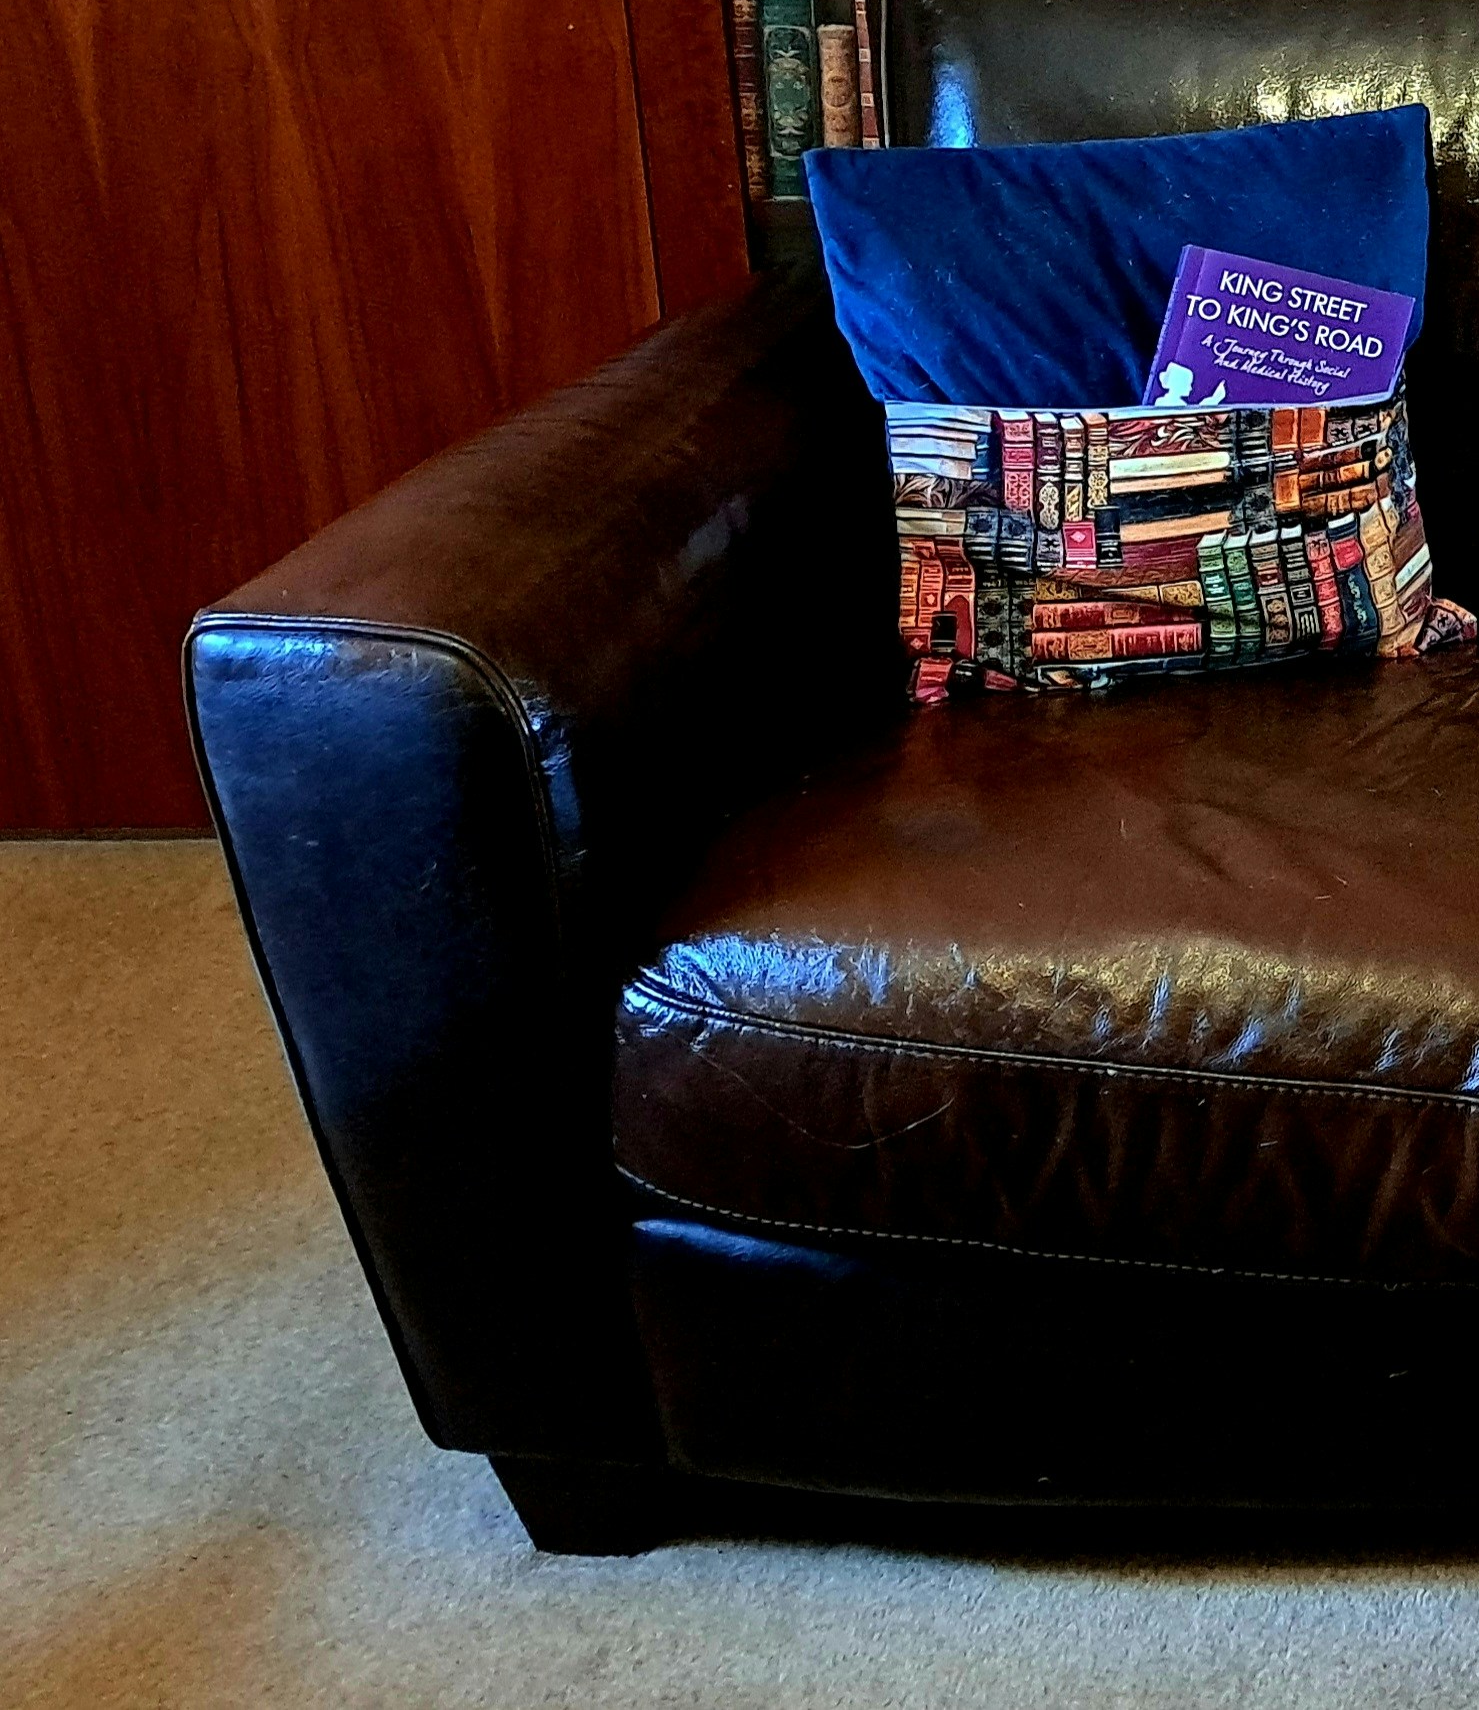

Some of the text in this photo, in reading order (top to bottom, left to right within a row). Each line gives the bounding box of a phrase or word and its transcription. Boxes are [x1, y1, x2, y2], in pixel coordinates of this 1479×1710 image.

[1219, 270, 1367, 323] KING STREET
[1186, 295, 1383, 358] TO KING'S ROAD
[1201, 334, 1350, 379] A Journey Through Social
[1214, 355, 1332, 396] And Medical History
